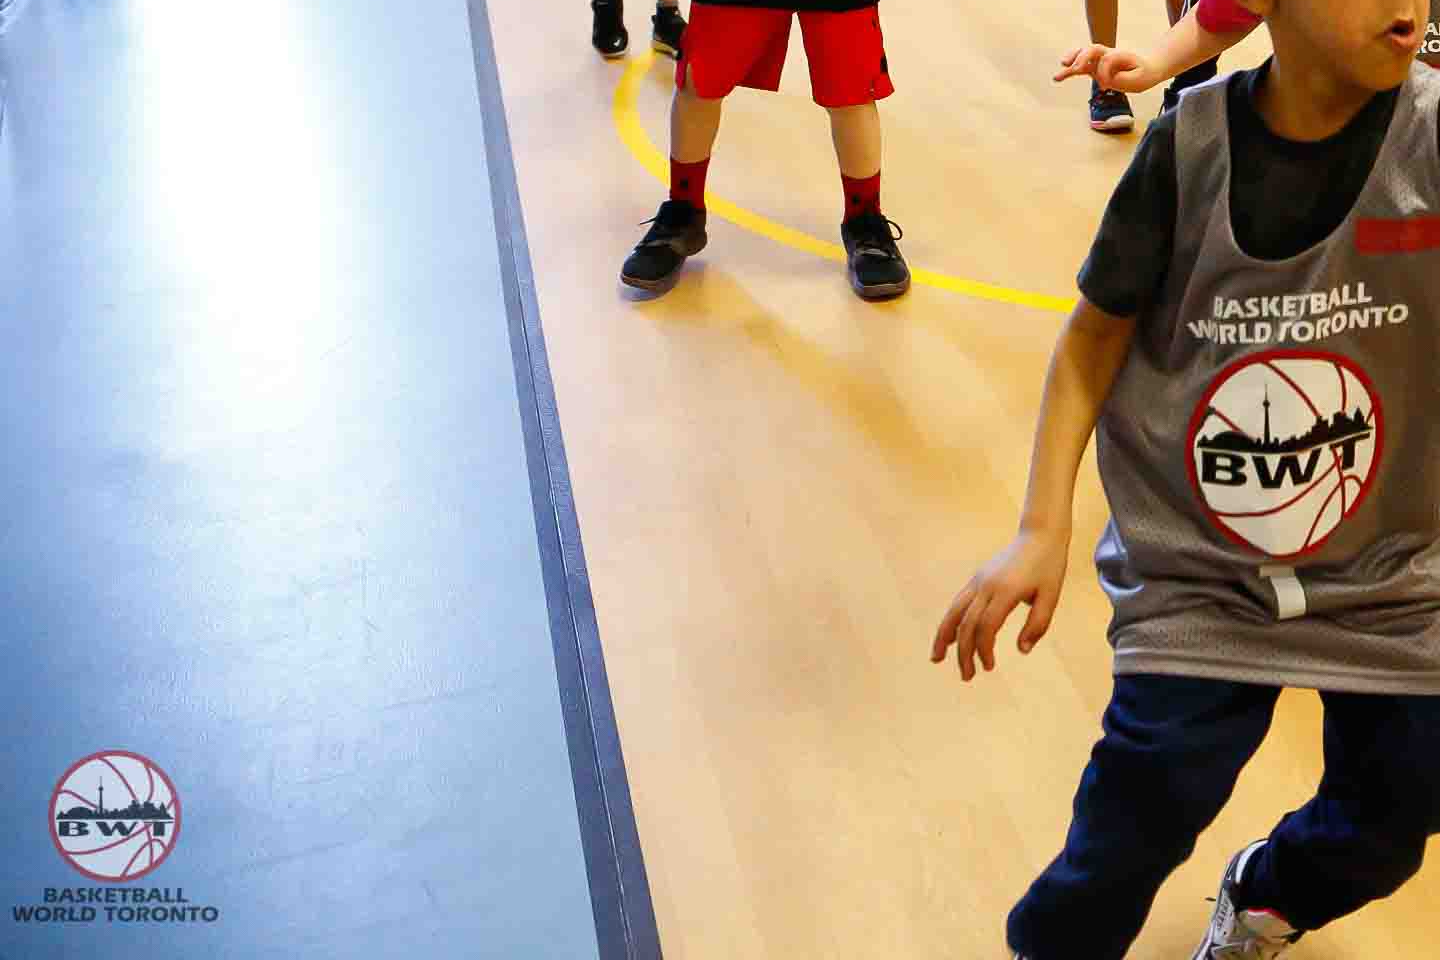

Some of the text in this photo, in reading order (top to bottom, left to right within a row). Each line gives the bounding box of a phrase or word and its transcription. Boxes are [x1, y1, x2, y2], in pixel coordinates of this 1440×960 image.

[1213, 281, 1373, 319] BASKETBALL
[1187, 303, 1409, 345] WRLD TORONTO
[1201, 431, 1371, 490] BWT
